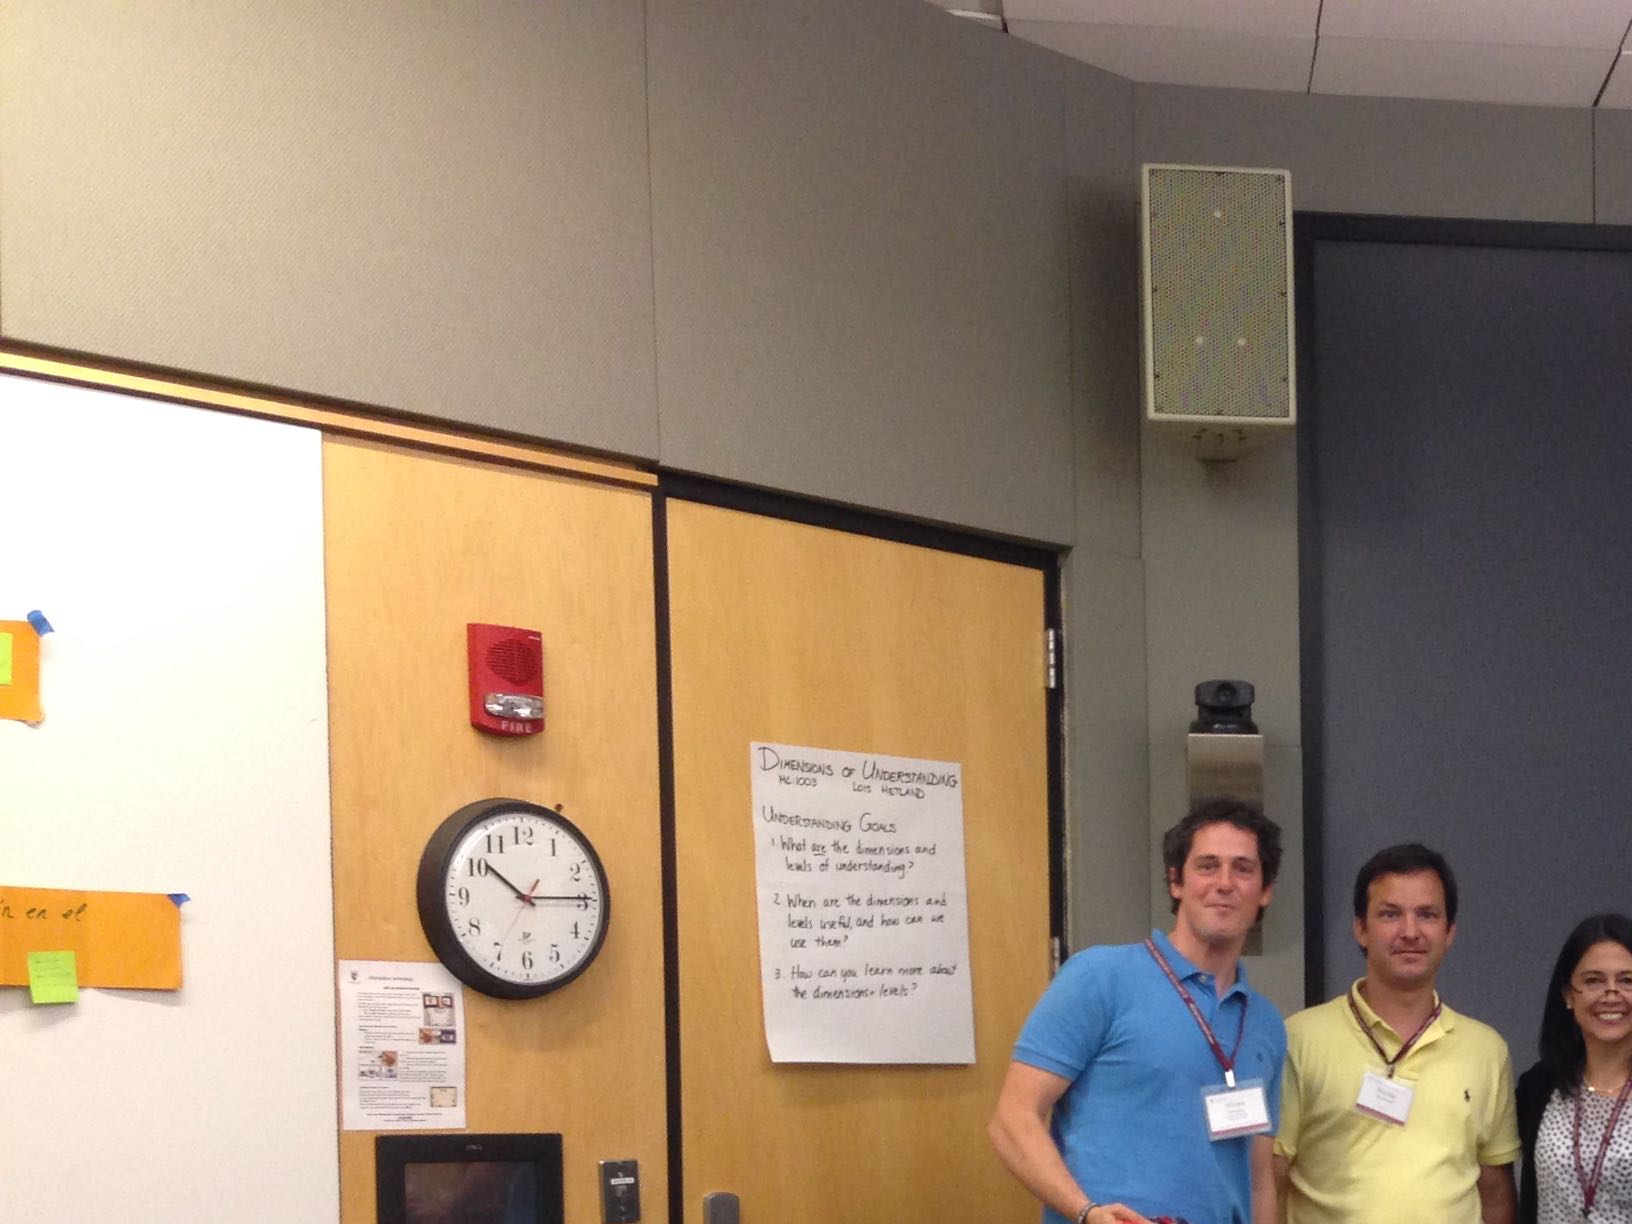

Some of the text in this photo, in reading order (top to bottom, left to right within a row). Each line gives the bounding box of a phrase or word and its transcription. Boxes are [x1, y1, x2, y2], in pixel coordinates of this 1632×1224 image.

[487, 834, 504, 854] 11
[513, 826, 534, 846] 12
[780, 835, 806, 852] What
[831, 840, 849, 854] the
[856, 840, 910, 856] dimensions
[915, 843, 936, 855] and
[550, 838, 556, 857] 1
[467, 857, 488, 877] 10
[569, 863, 580, 882] 2
[819, 857, 829, 872] of
[458, 887, 470, 907] 9
[576, 892, 588, 911] 3
[786, 893, 816, 908] When
[823, 898, 840, 908] are
[845, 893, 861, 906] the
[926, 891, 947, 906] and
[468, 917, 481, 937] 8
[569, 921, 580, 939] 4
[856, 914, 874, 928] and
[493, 941, 503, 961] 7
[522, 951, 533, 970] 6
[549, 944, 560, 962] 5
[791, 963, 813, 979] How
[818, 968, 837, 978] can
